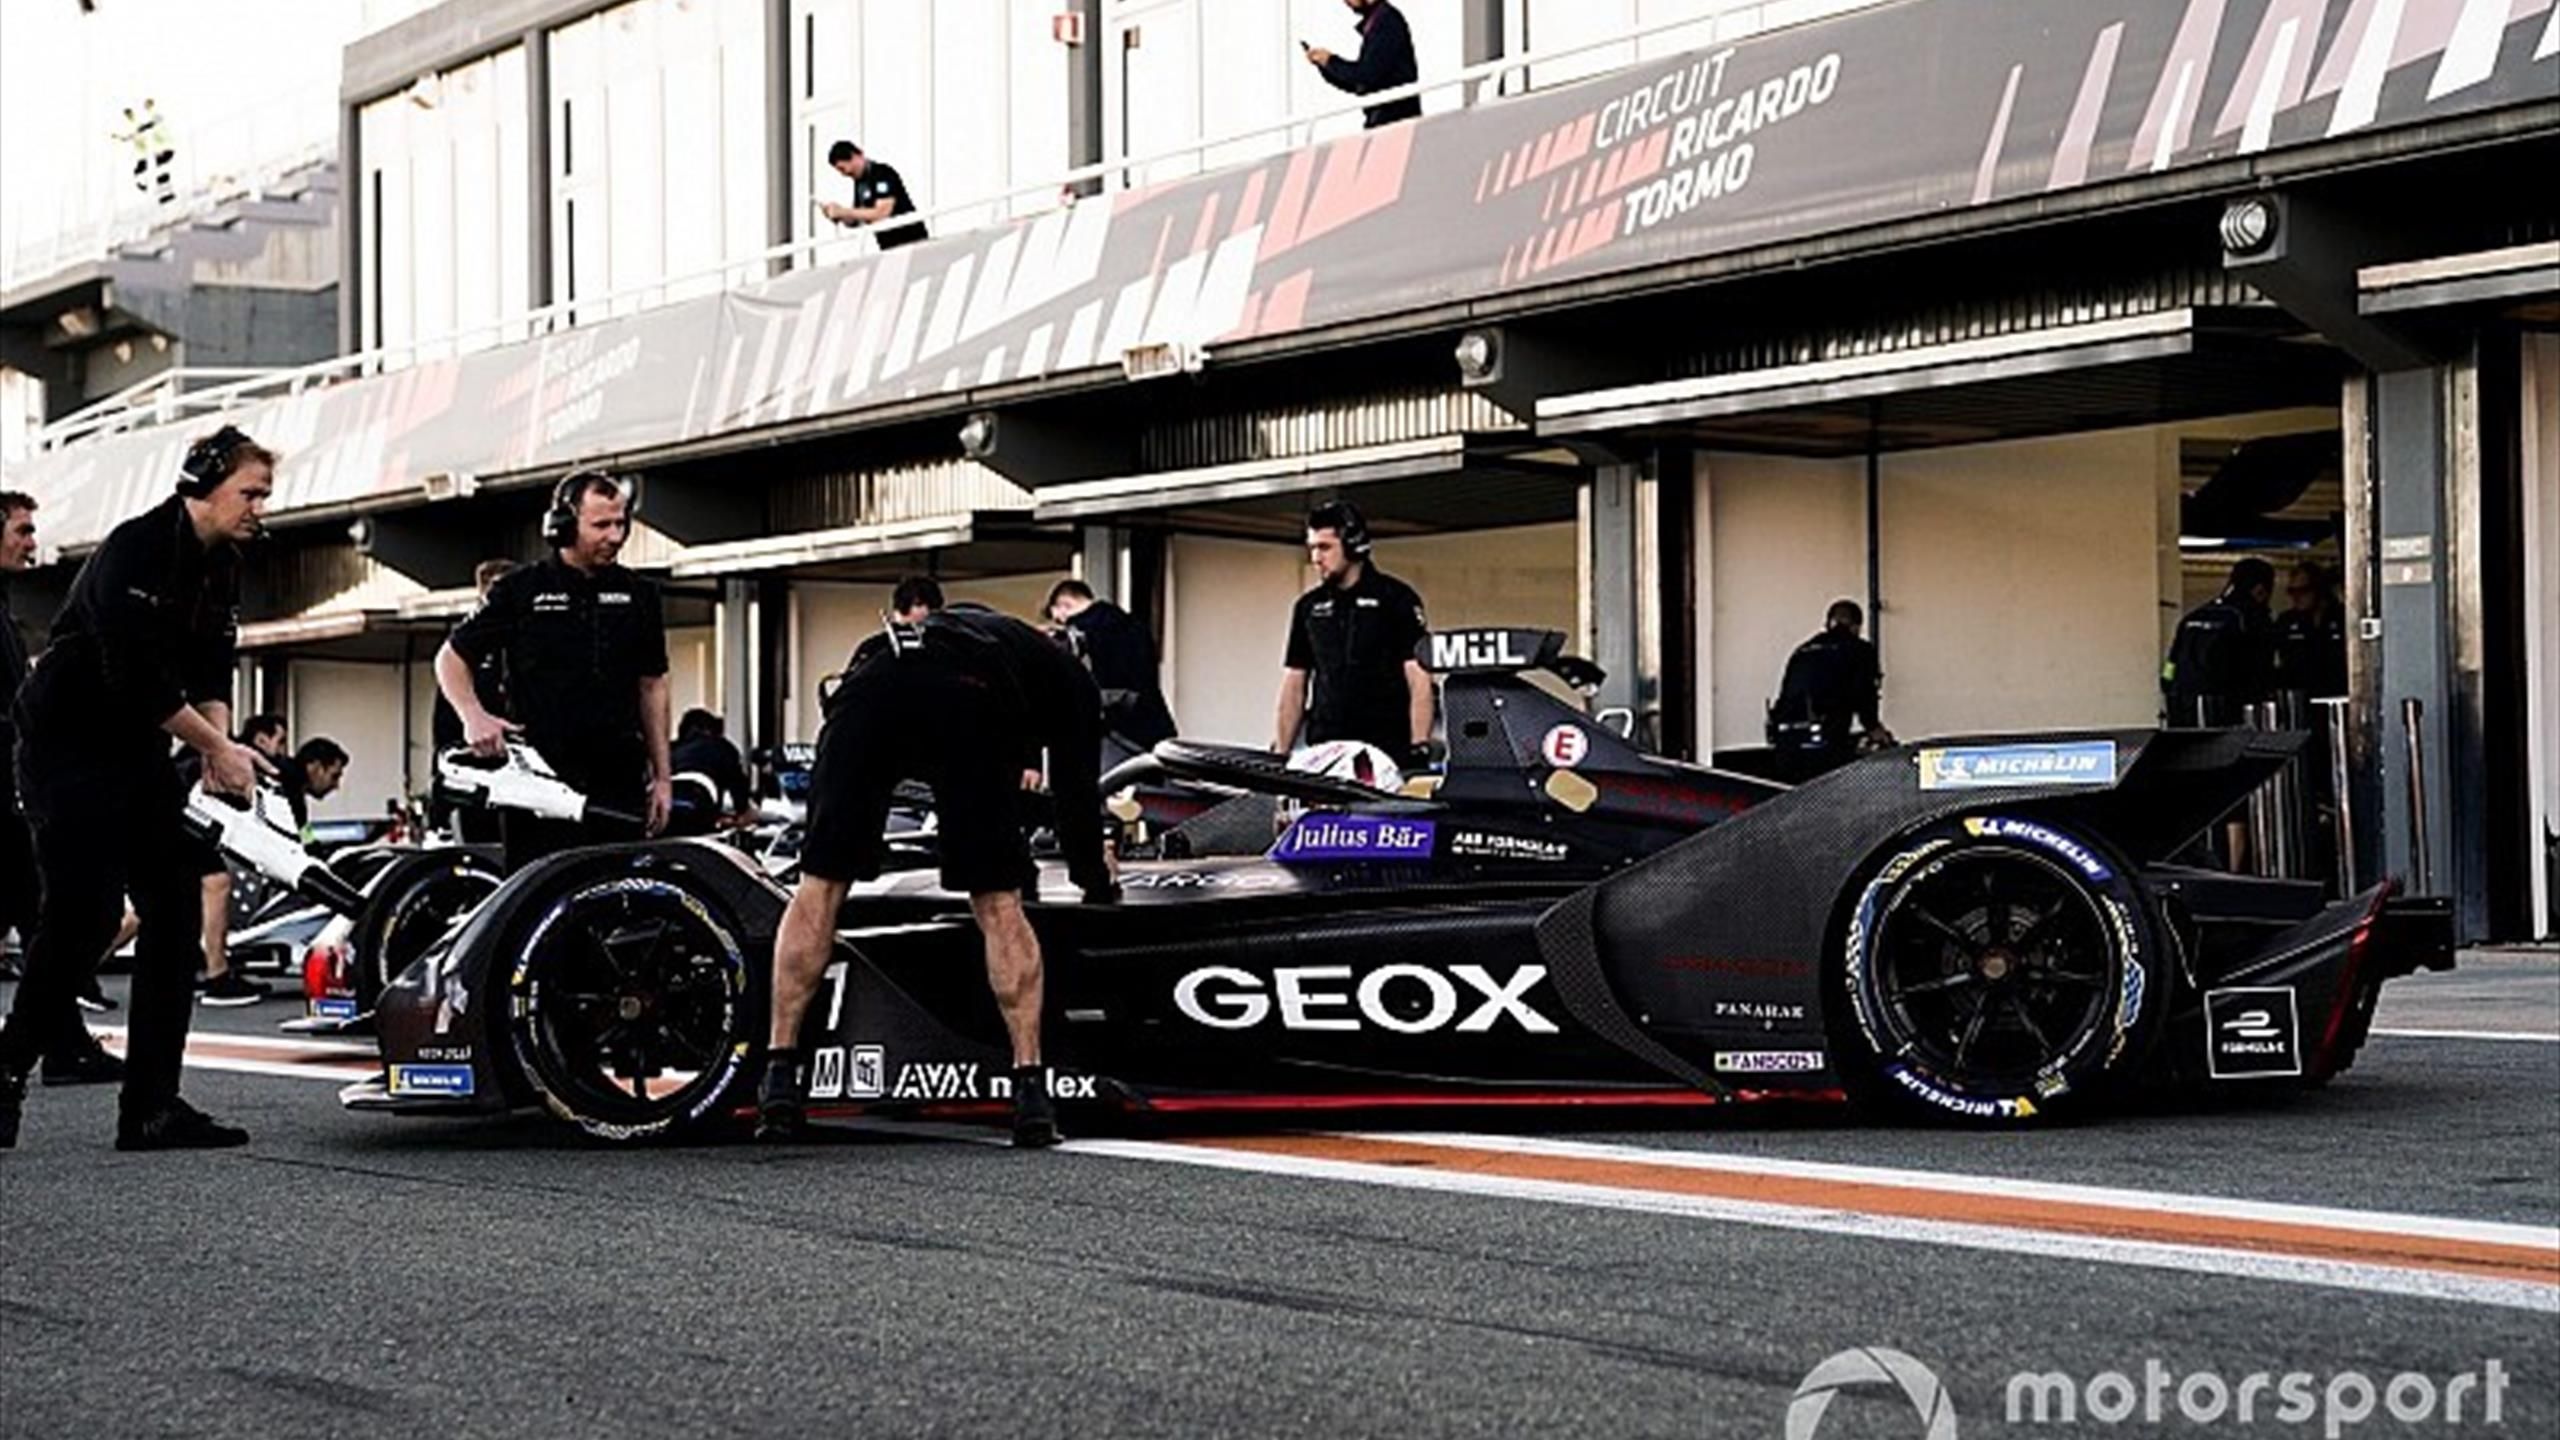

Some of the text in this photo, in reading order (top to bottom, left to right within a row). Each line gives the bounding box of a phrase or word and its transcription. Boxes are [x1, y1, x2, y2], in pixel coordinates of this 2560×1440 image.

[1595, 49, 1736, 148] CIRCUIT
[1667, 54, 1840, 168] RICARDO
[1624, 144, 1754, 235] TORMO
[1554, 731, 1576, 761] E
[1974, 755, 2098, 775] MICHELIN
[1294, 823, 1428, 851] Julius Bär
[2003, 820, 2102, 879] MICHELIN
[1173, 963, 1560, 1033] GEOX
[1894, 1069, 1995, 1117] MICHELIN
